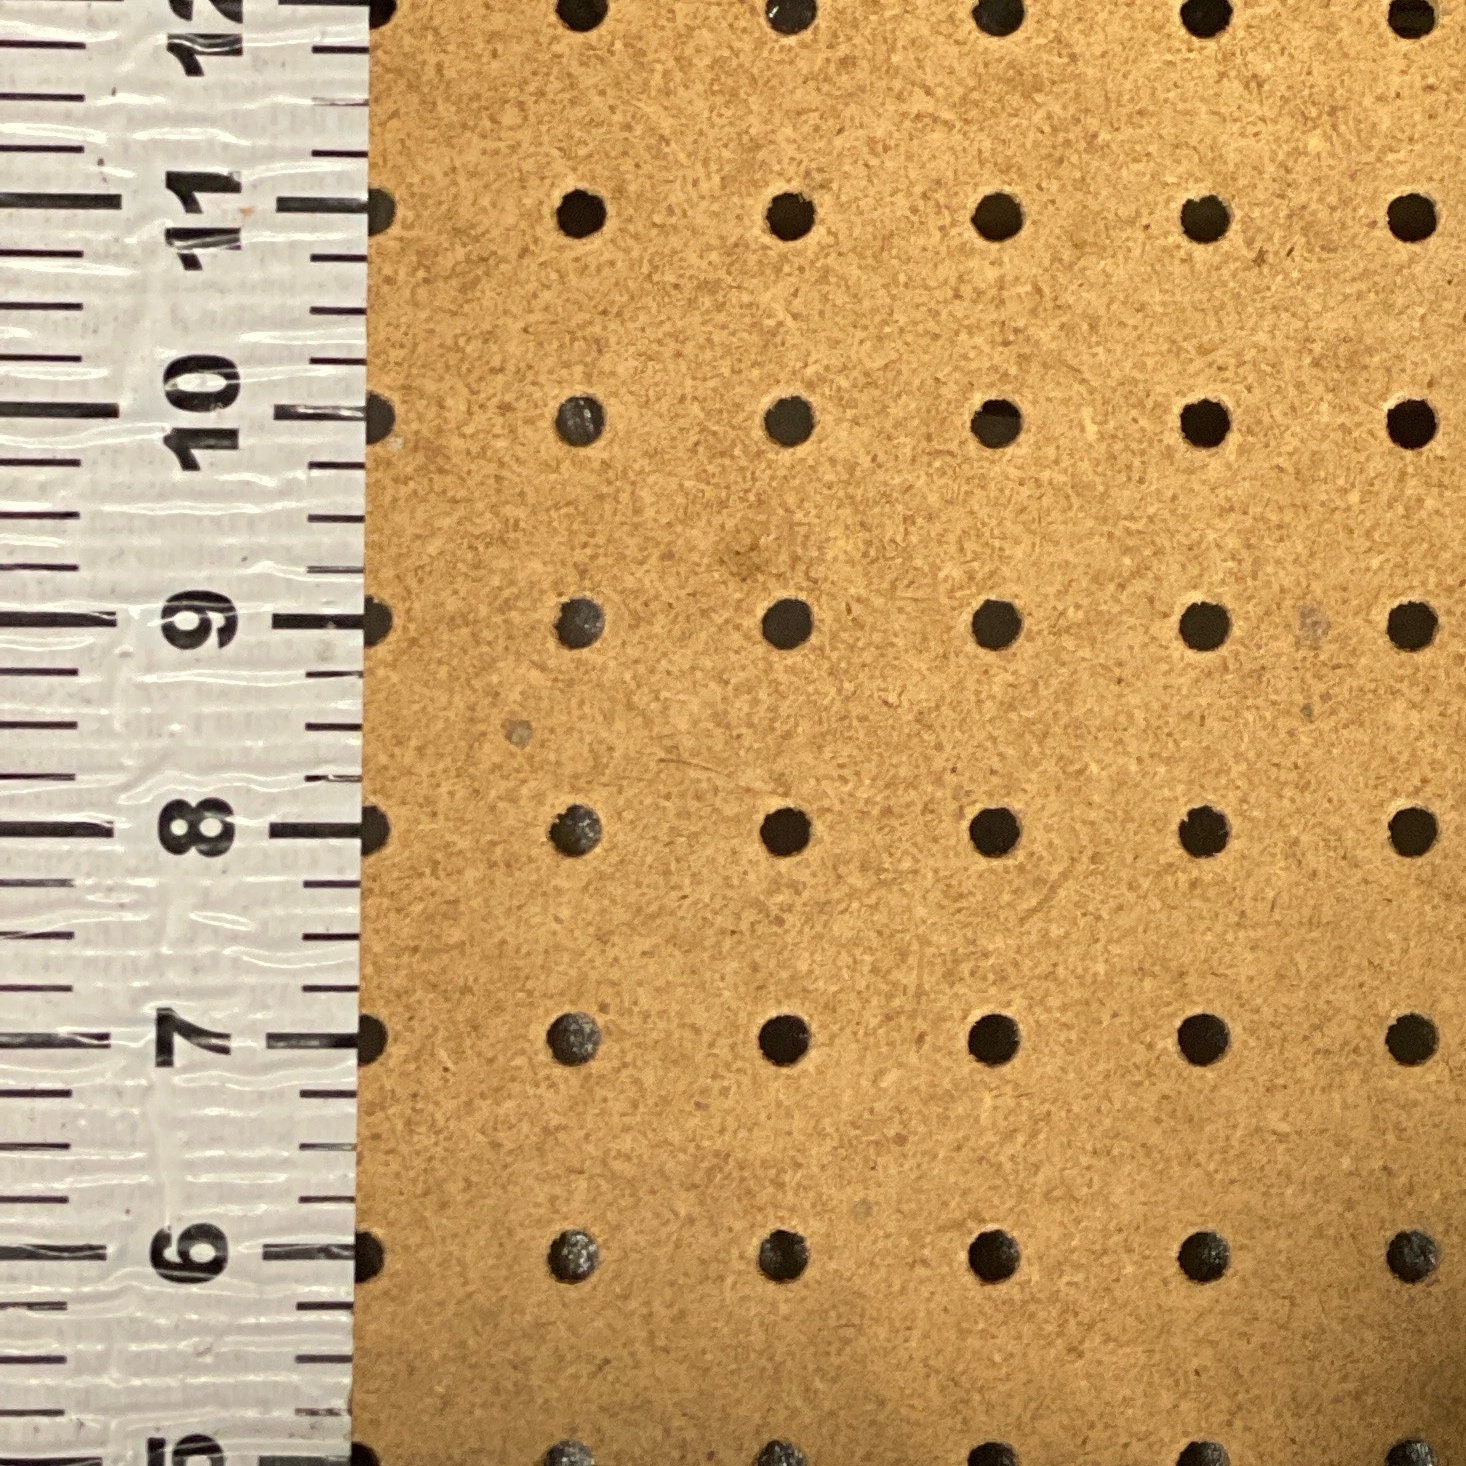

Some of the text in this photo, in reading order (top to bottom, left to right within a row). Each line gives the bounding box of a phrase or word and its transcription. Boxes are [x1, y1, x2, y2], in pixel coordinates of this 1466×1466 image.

[164, 170, 242, 271] 11
[162, 354, 241, 472] 10
[160, 589, 239, 650] 9
[157, 797, 236, 858] 8
[154, 1007, 232, 1068] 7
[150, 1222, 229, 1284] 6
